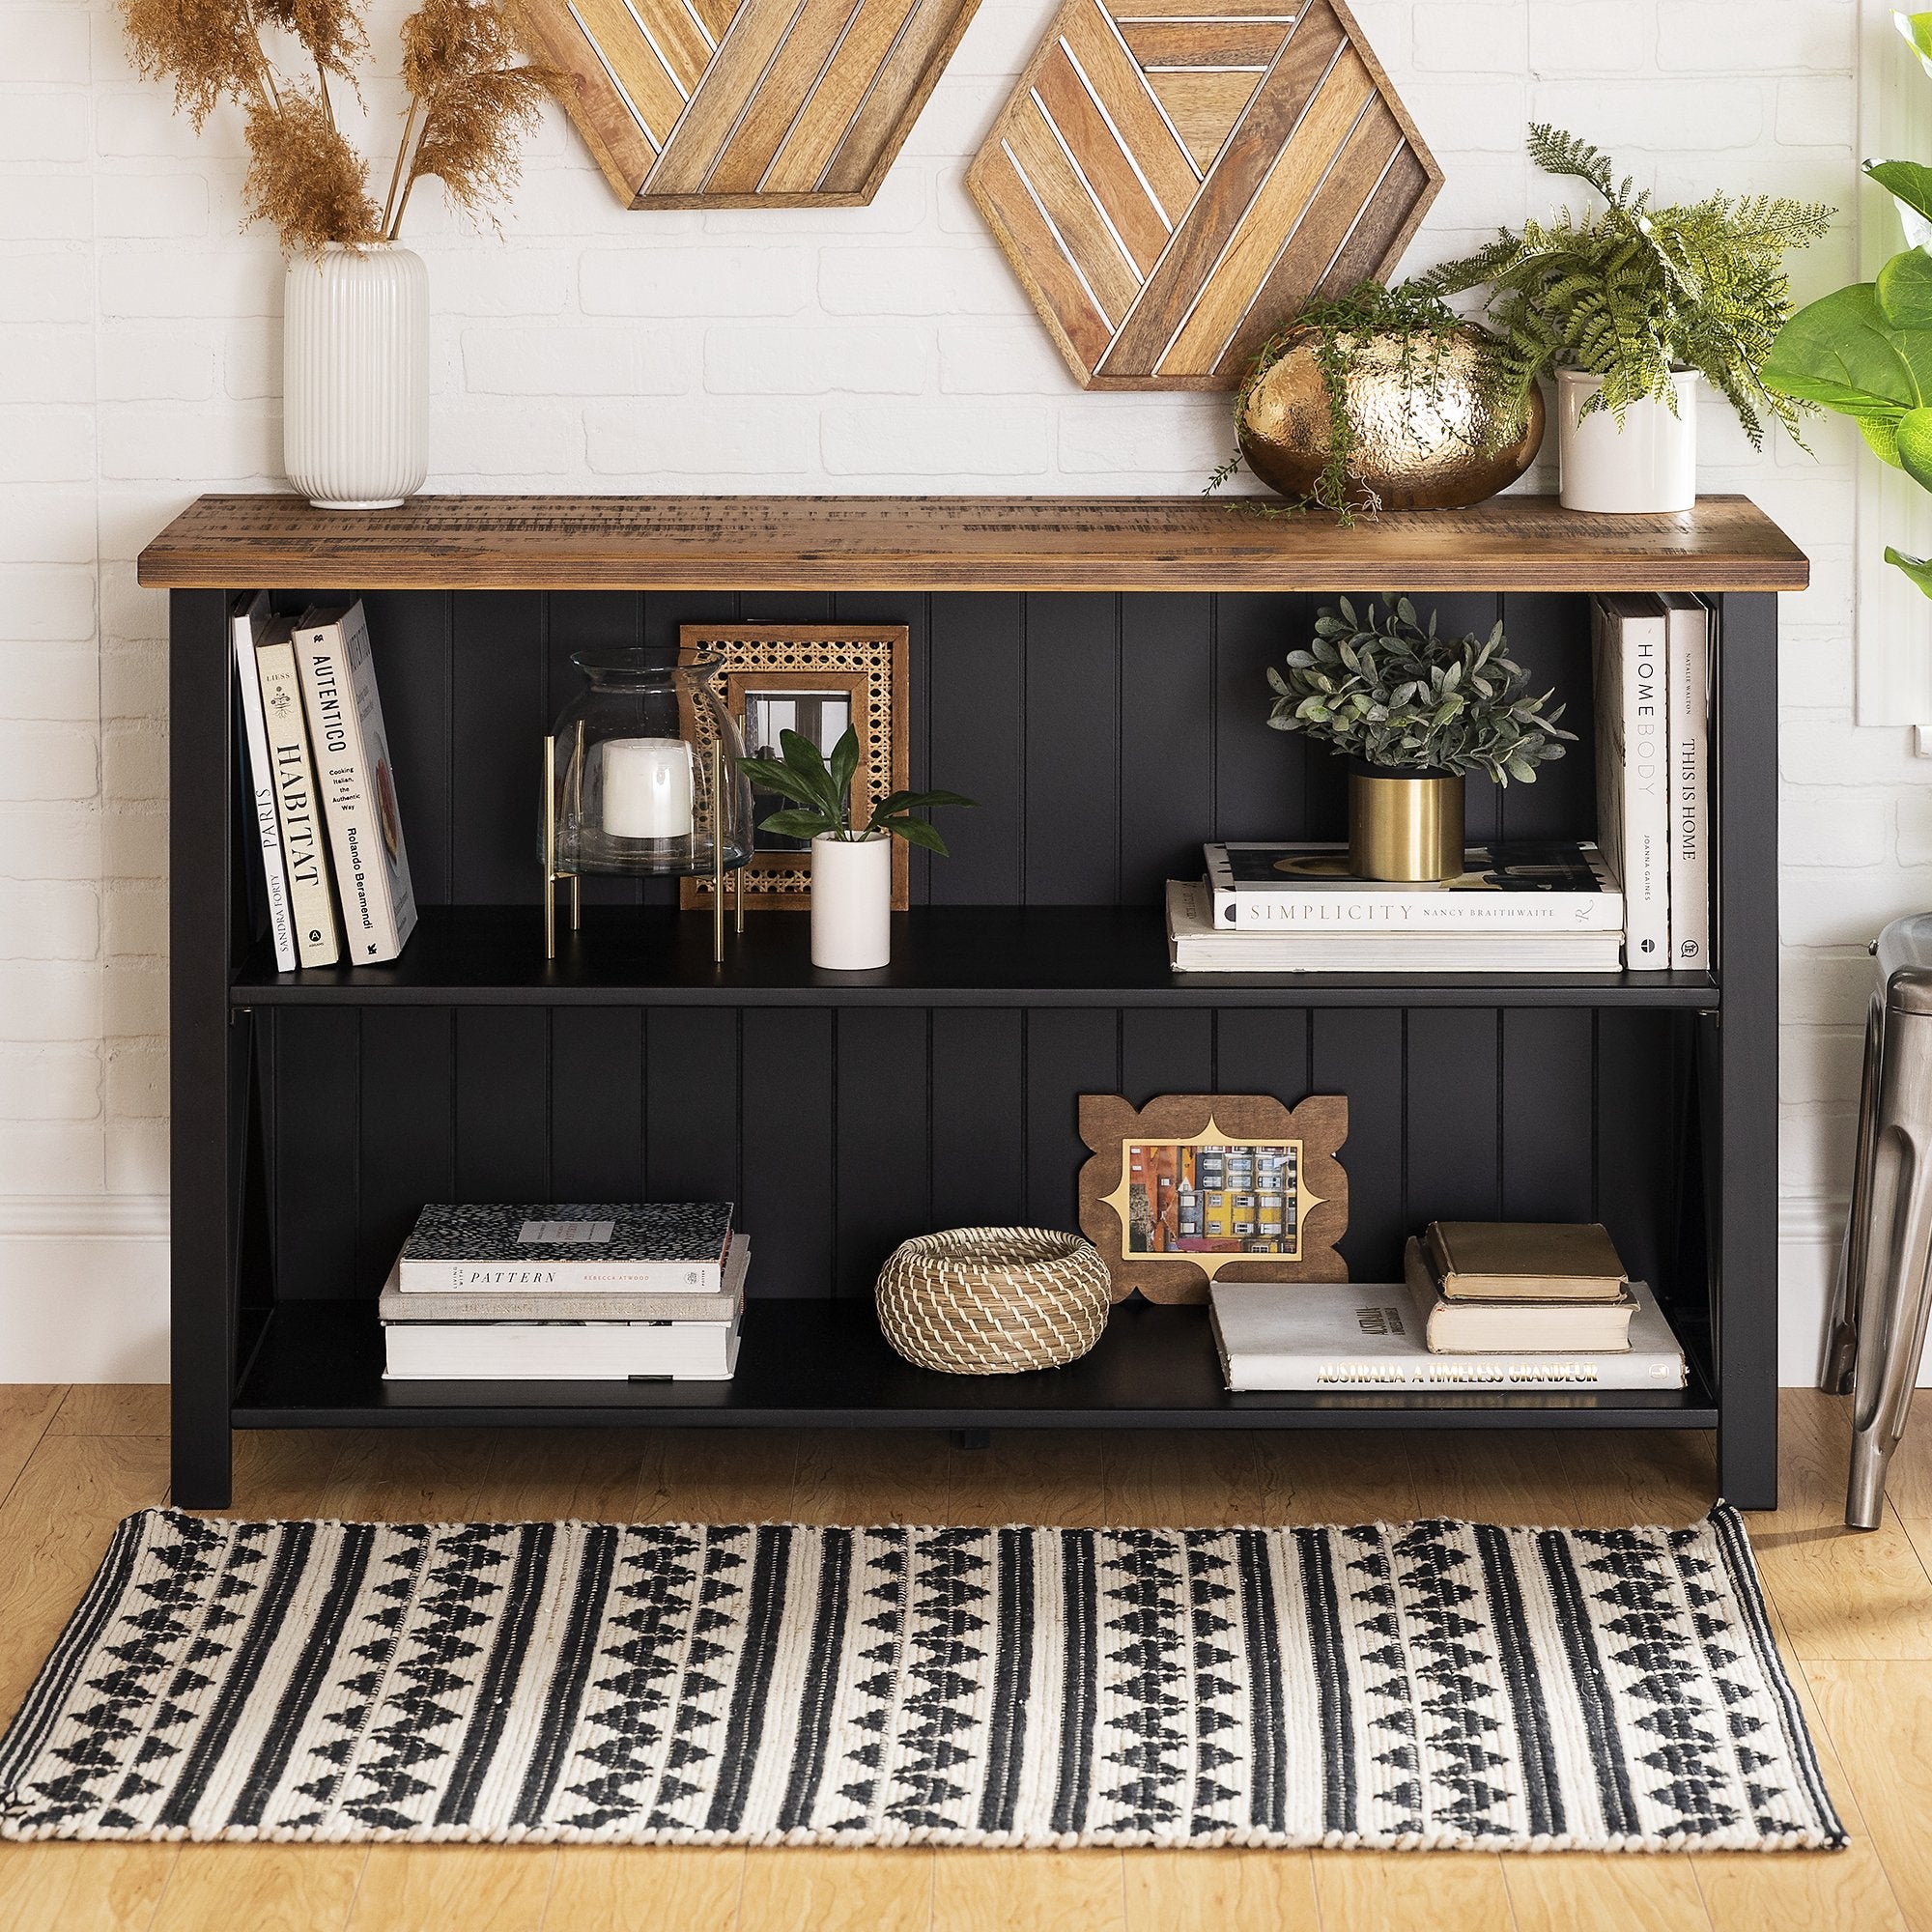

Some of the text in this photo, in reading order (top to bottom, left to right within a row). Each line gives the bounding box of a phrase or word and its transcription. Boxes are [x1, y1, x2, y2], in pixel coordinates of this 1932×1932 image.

[312, 656, 347, 753] AUTENTICO
[1637, 644, 1655, 796] HOMEBODY
[328, 767, 355, 776] Cooking
[332, 793, 361, 804] Authentic
[1682, 738, 1696, 861] THIS IS HOME
[255, 788, 278, 848] PARIS
[276, 744, 319, 887] HABITAT
[347, 827, 374, 929] Rolando Beramendi
[1250, 904, 1555, 920] SIMPLICITY NANCY BRAITHWAITE
[270, 874, 289, 952] SANDRA FORTY
[470, 1272, 556, 1283] PATTERN
[1317, 1363, 1599, 1384] AUSTRALIA A TIMELESS GRANDEUR
